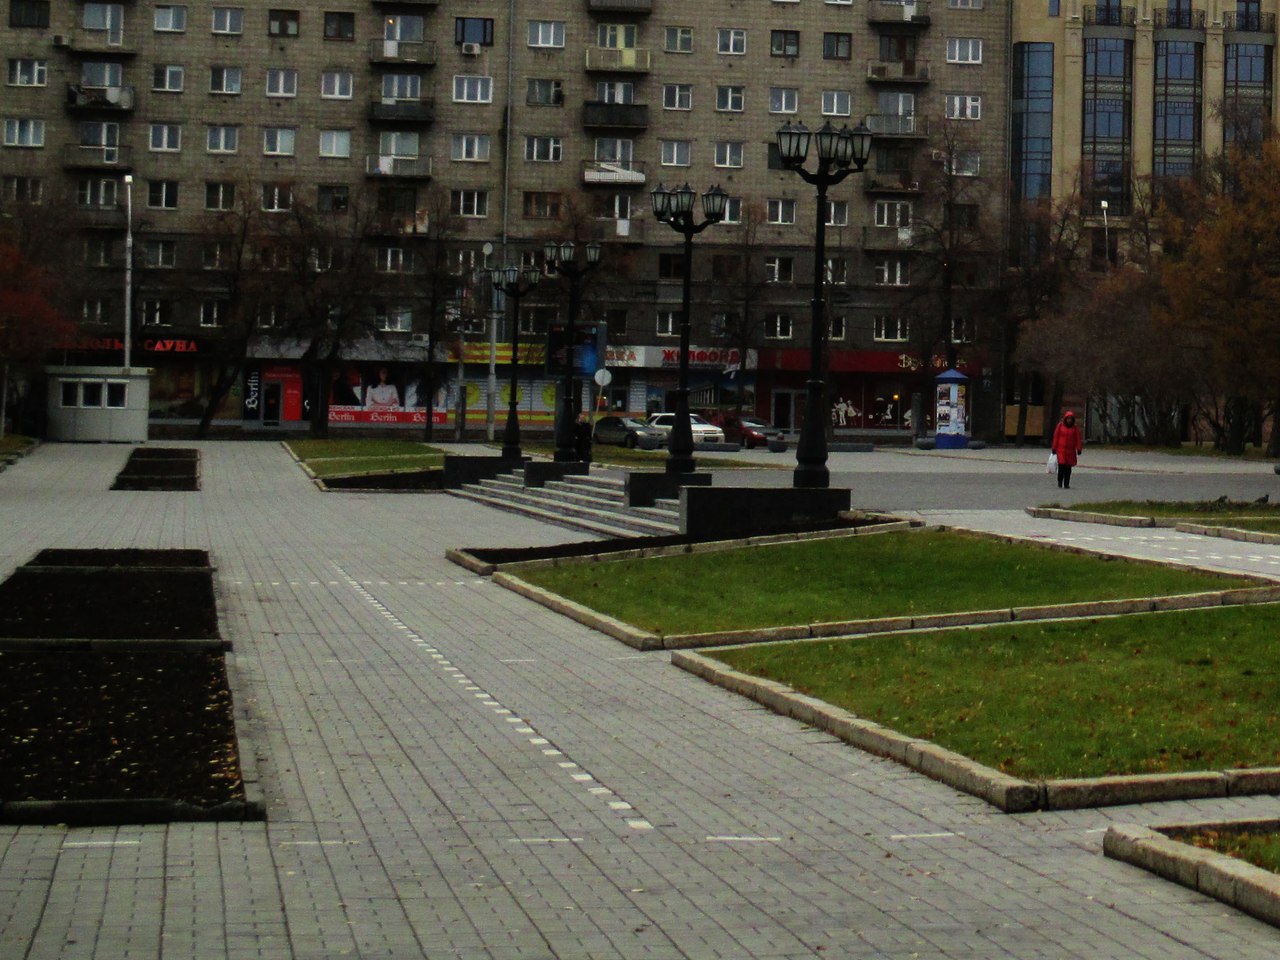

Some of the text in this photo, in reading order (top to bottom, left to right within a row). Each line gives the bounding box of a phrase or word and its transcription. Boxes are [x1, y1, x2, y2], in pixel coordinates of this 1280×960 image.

[143, 339, 198, 352] САУНА
[245, 370, 260, 411] Berlin
[328, 411, 355, 421] Berlin
[370, 412, 397, 422] Berlin
[412, 413, 440, 422] Bein
